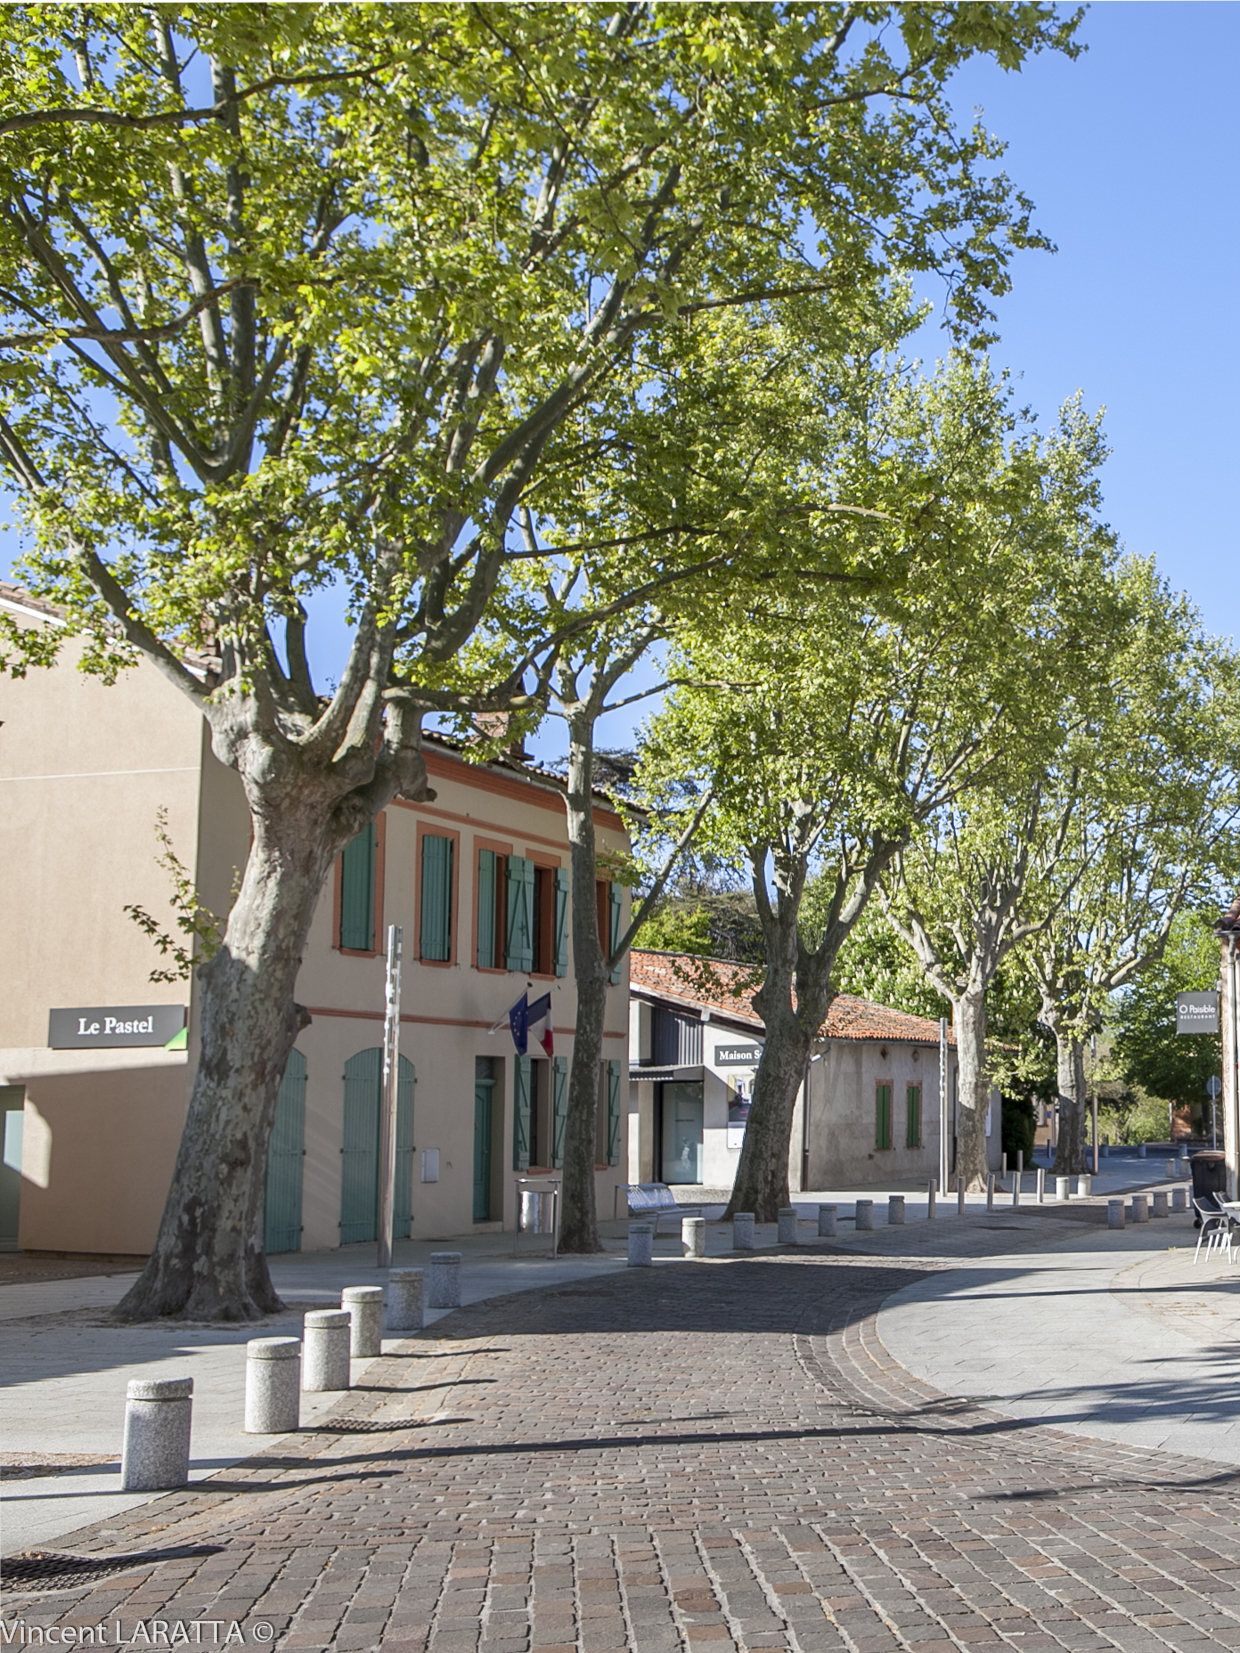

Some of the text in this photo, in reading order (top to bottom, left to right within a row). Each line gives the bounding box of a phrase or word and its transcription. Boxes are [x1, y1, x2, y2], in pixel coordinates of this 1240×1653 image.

[1190, 1004, 1216, 1013] Paisible
[78, 1016, 153, 1035] Le Pastel
[719, 1051, 752, 1060] Maison
